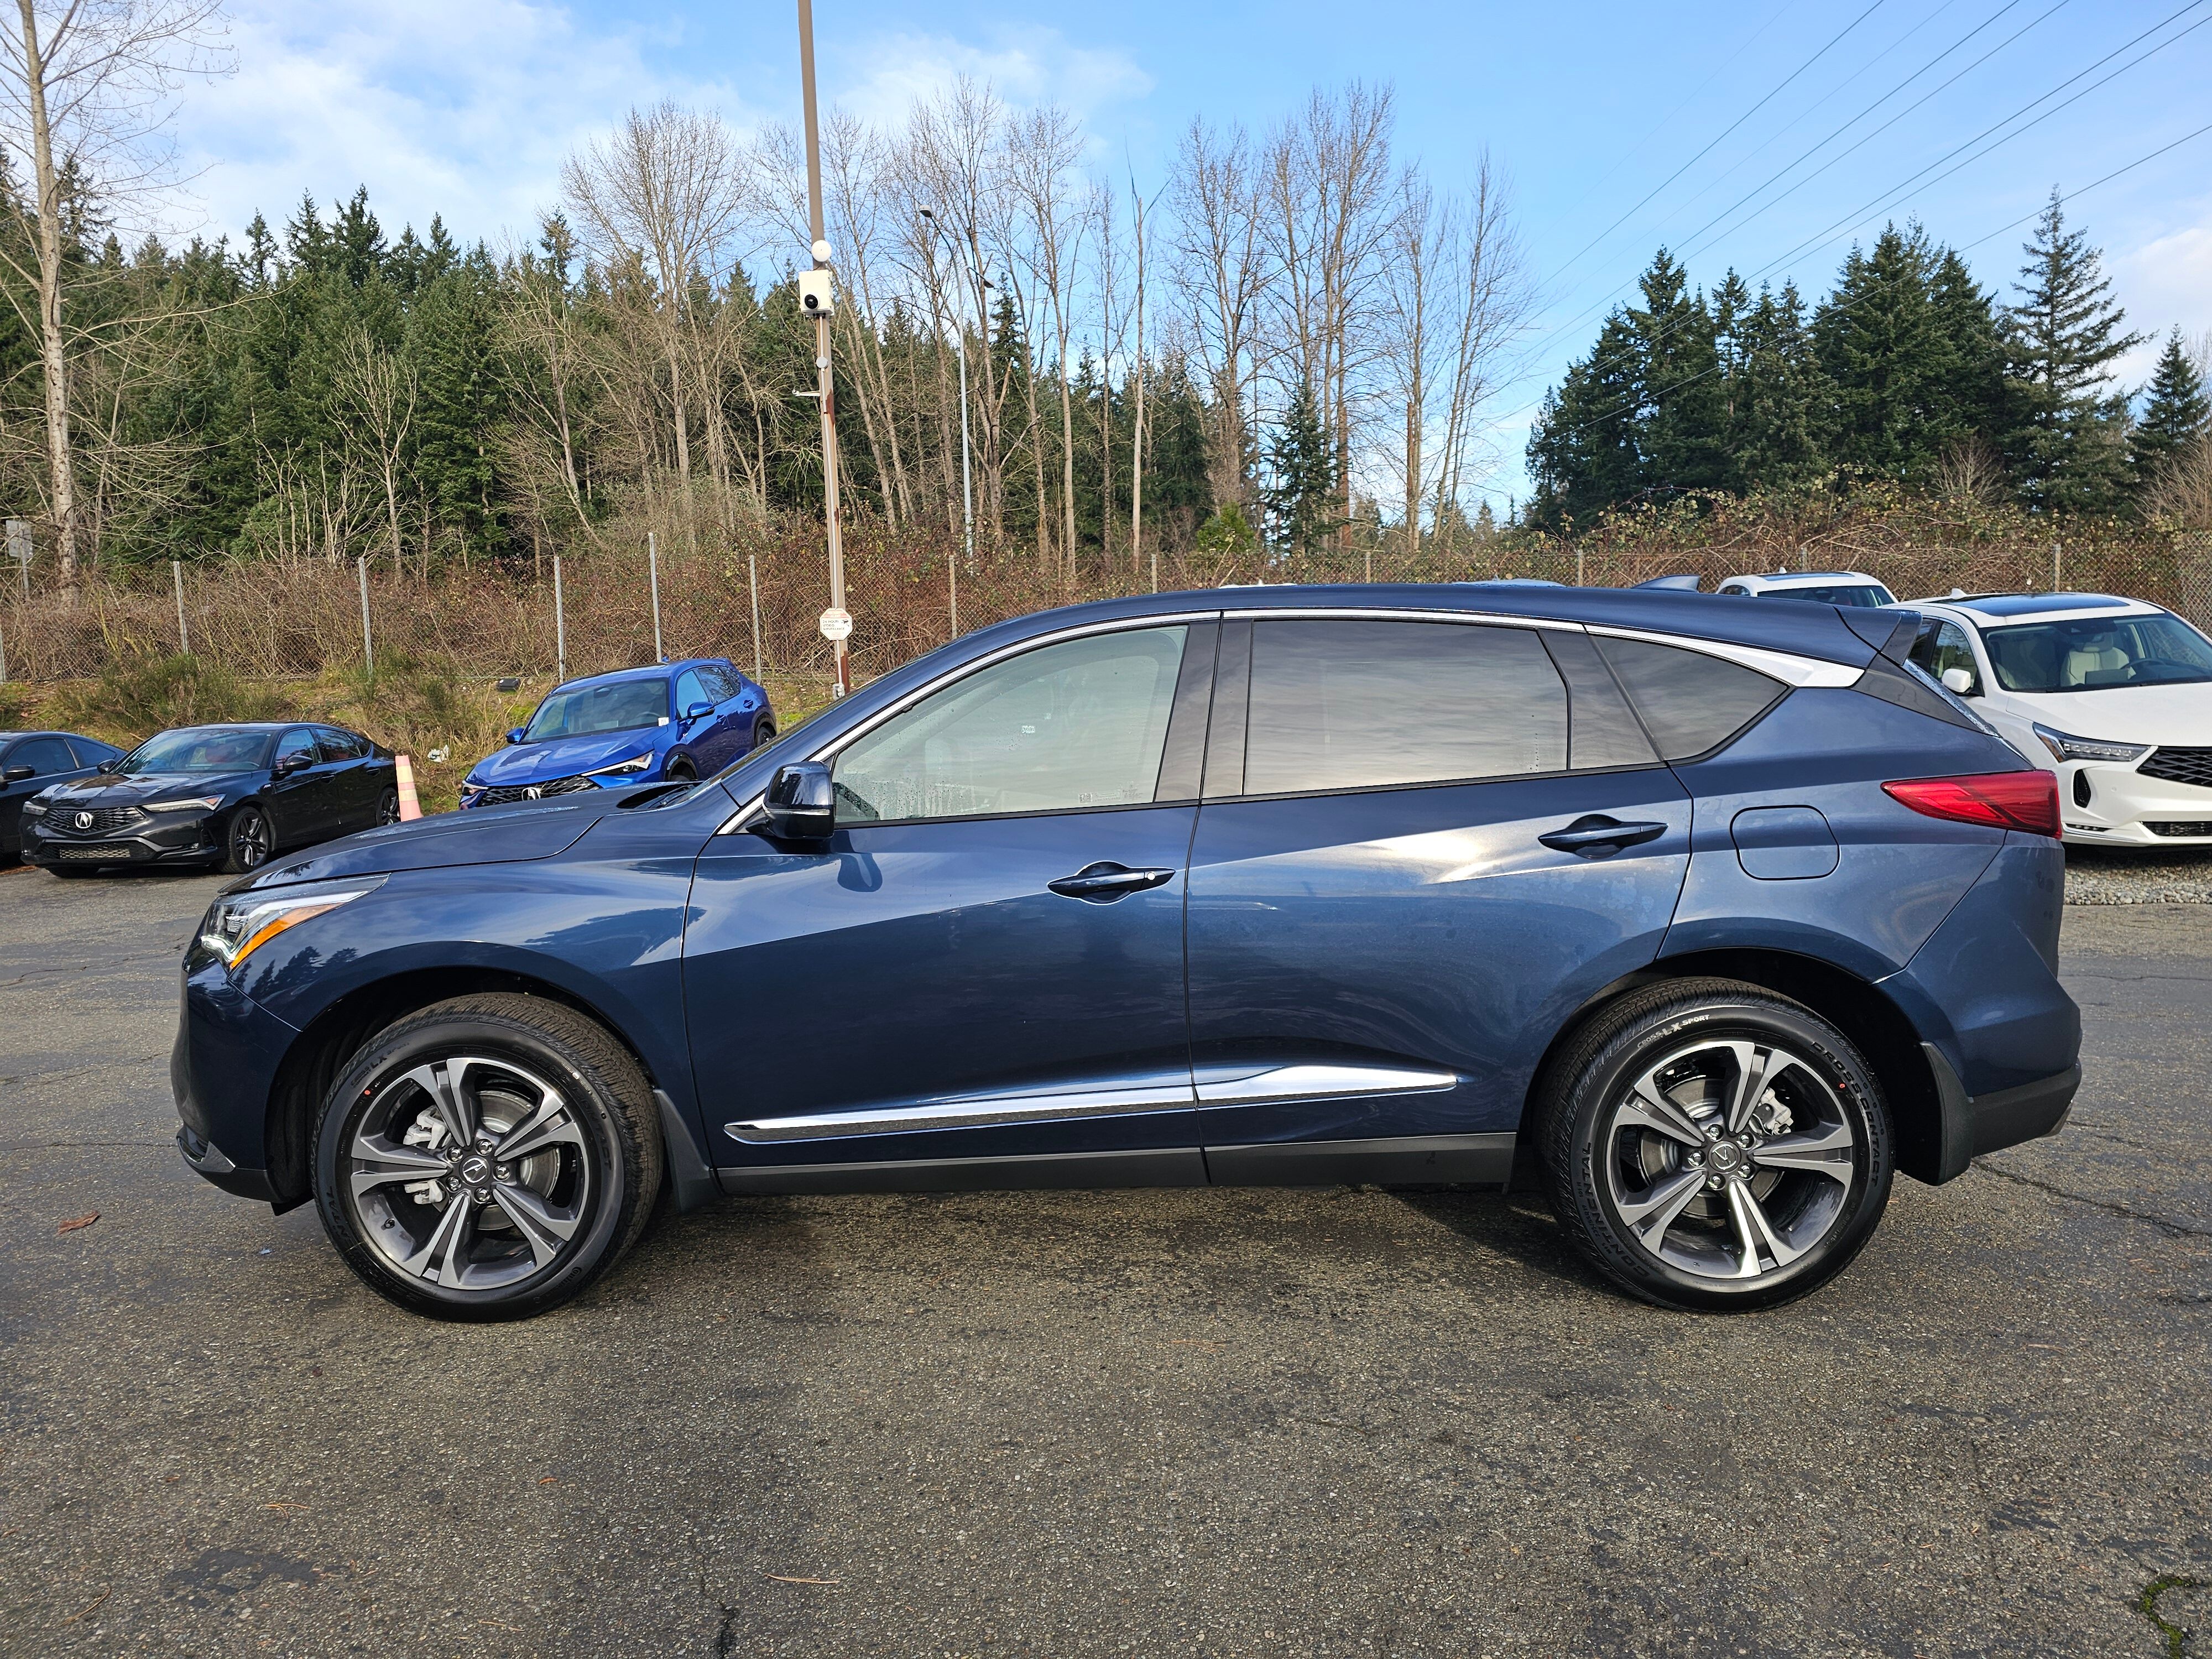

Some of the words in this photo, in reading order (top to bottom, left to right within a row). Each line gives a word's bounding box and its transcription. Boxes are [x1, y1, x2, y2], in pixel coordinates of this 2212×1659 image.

[1637, 1031, 1662, 1048] CROSS
[1662, 1022, 1682, 1036] LX
[1682, 1014, 1710, 1026] SPORT
[370, 1054, 387, 1069] LX
[1582, 1142, 1651, 1277] CONTINENTAL
